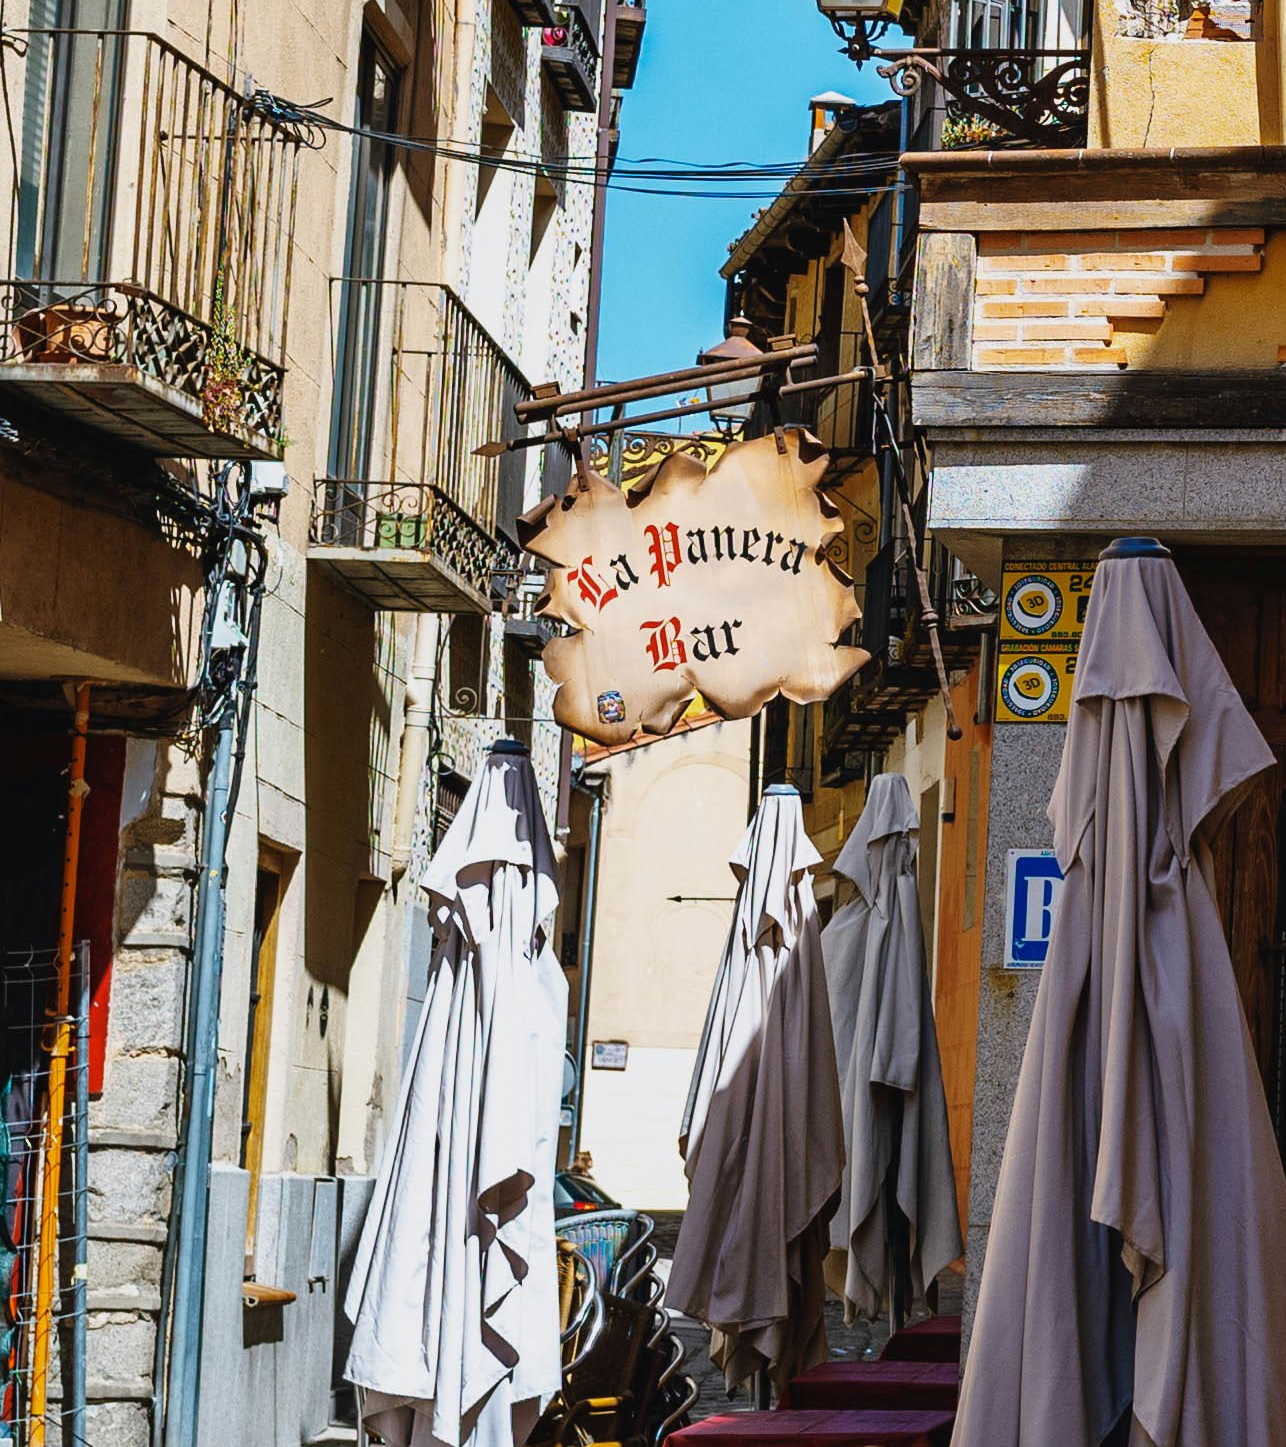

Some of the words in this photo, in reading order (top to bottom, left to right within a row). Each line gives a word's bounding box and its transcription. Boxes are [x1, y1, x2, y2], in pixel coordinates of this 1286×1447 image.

[567, 554, 640, 613] La
[643, 521, 809, 589] Panera
[1026, 596, 1045, 609] 3D
[638, 615, 743, 674] Bar
[1022, 677, 1041, 691] 3D
